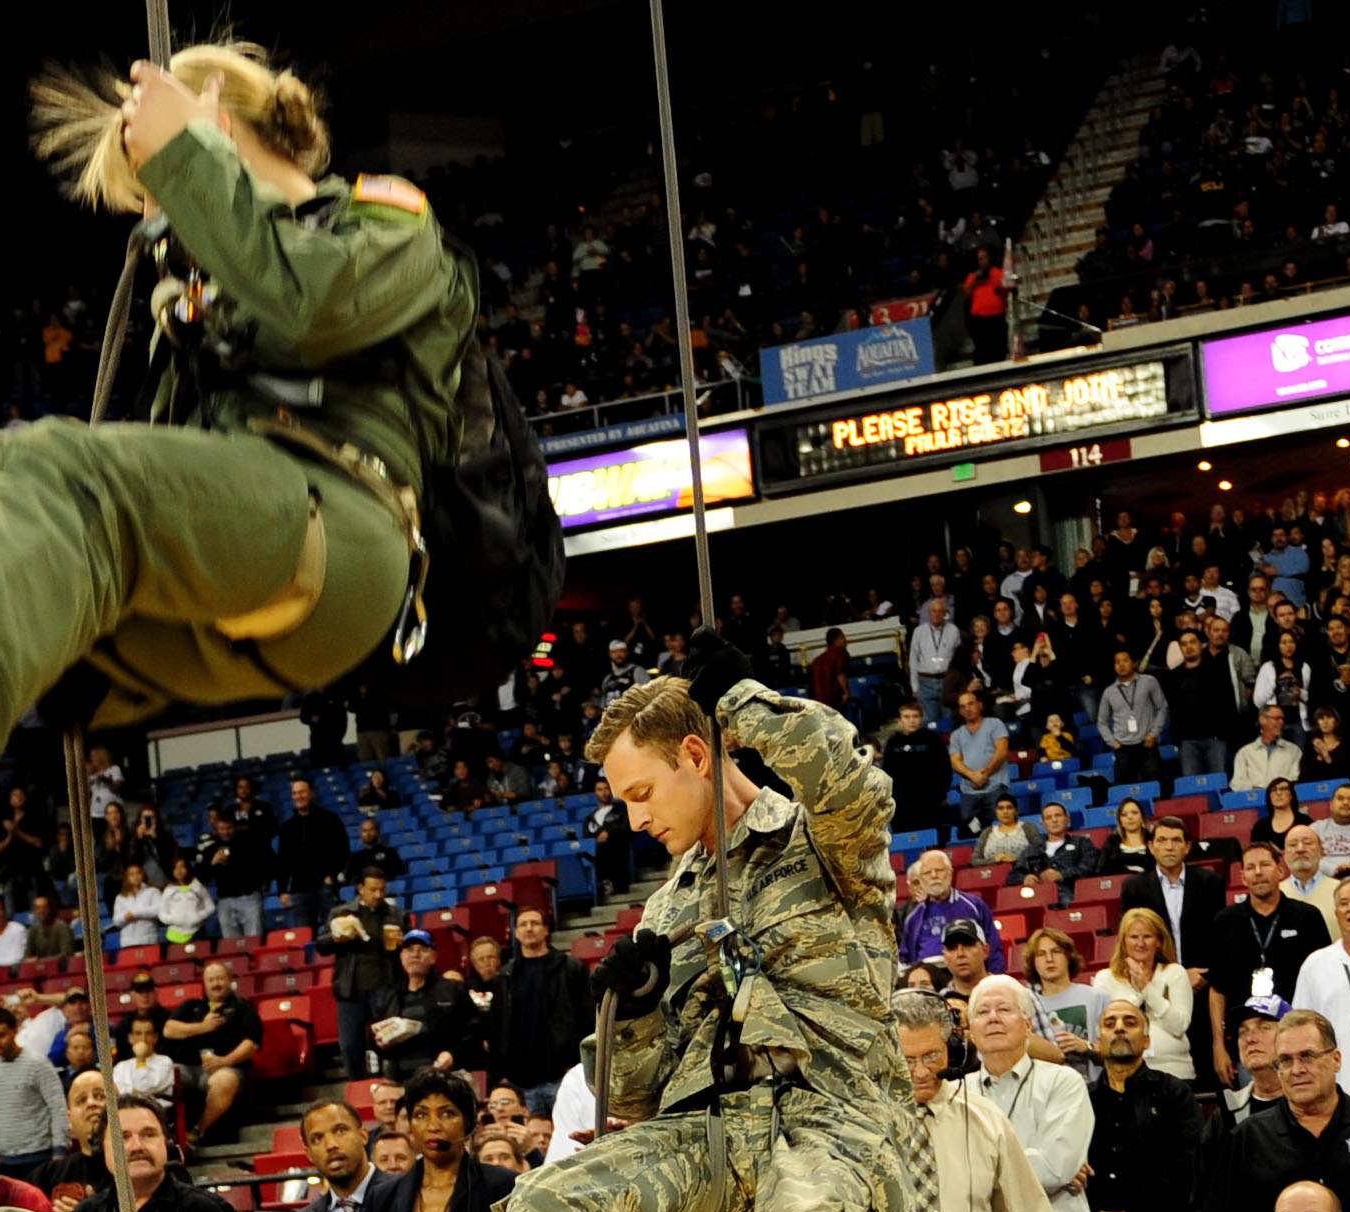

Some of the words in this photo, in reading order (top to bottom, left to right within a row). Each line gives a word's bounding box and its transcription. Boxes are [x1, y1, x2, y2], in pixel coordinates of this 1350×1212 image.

[780, 343, 838, 367] Kings
[857, 339, 919, 371] AQUAFINA
[786, 379, 837, 400] TEAM
[832, 406, 923, 450] PLEASE
[930, 394, 992, 431] RISE
[999, 384, 1048, 417] AND
[547, 432, 606, 451] PRESENTED
[609, 429, 623, 440] BY
[627, 418, 680, 437] AQUAFINA
[904, 427, 962, 456] PAULA
[1069, 444, 1103, 469] 114
[773, 859, 809, 882] FORCE
